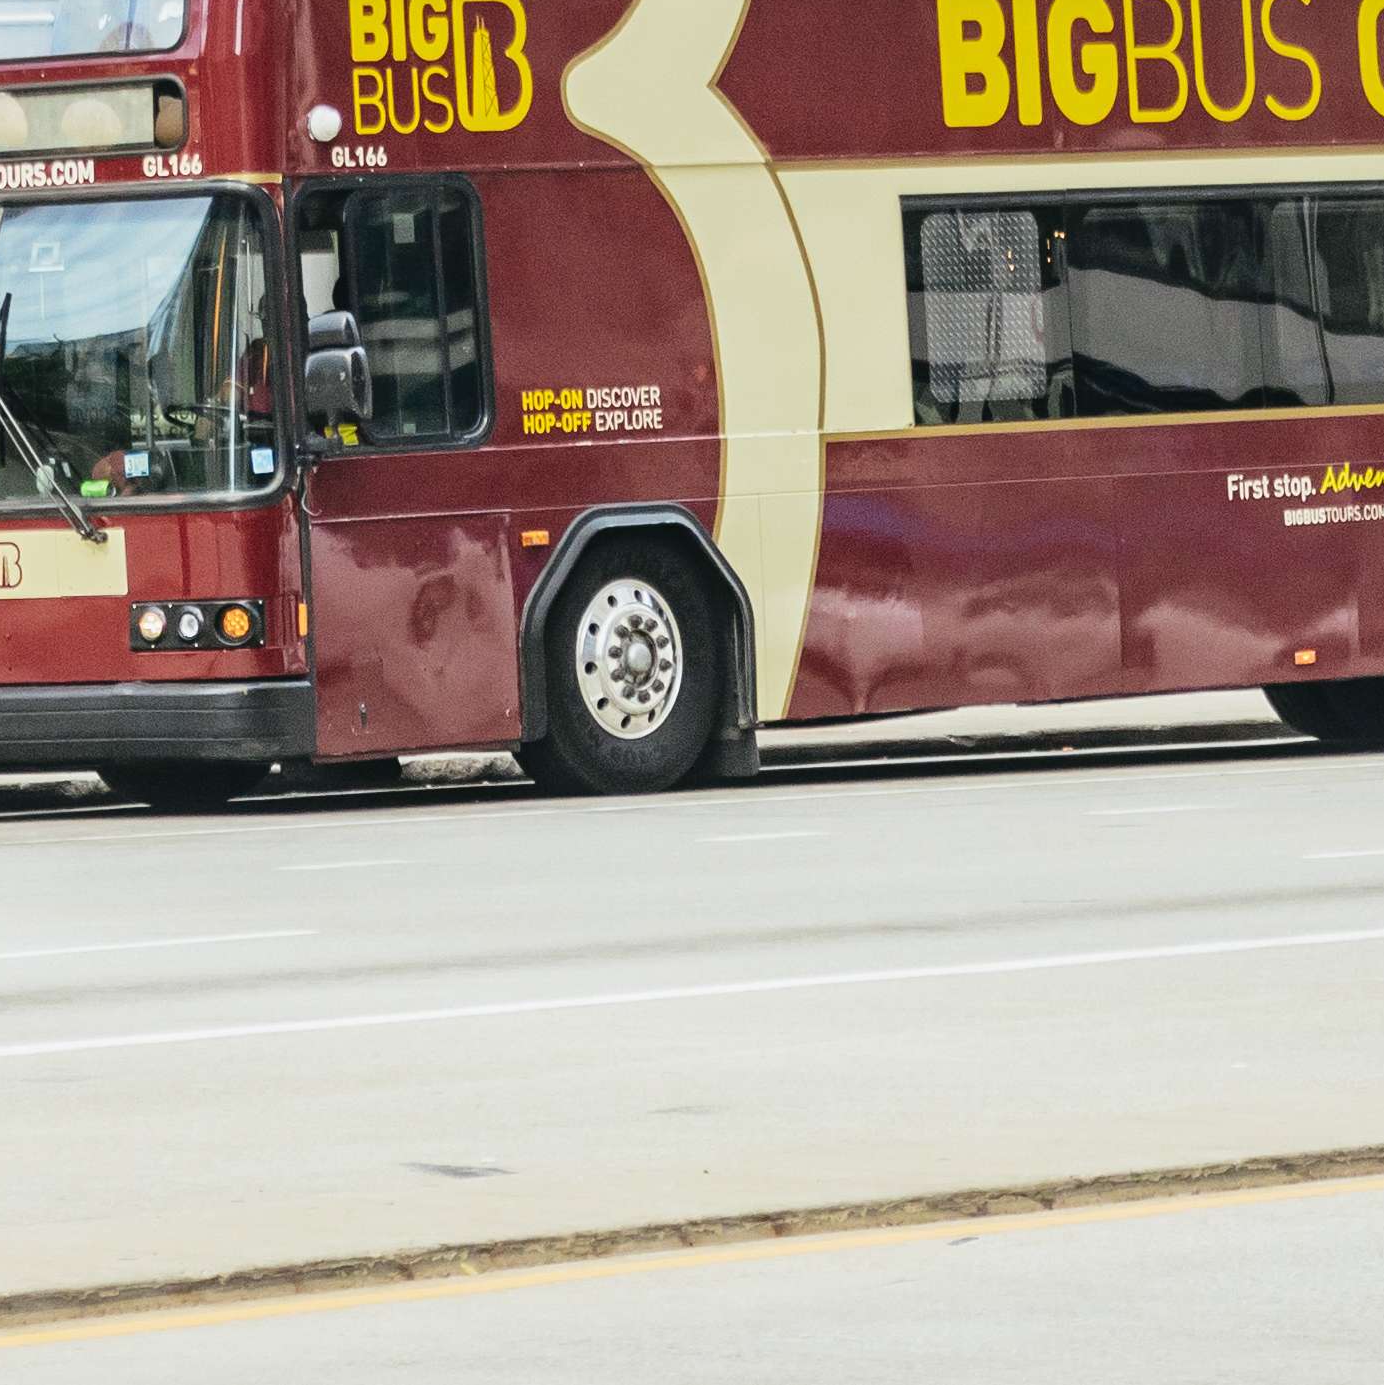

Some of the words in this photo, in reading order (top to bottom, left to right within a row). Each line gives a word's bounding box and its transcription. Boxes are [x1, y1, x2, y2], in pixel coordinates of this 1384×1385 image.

[351, 66, 454, 136] BUS
[142, 154, 203, 179] GL166
[330, 145, 388, 169] GL166
[521, 387, 583, 412] HOP-ON
[586, 385, 661, 409] DISCOVER
[523, 411, 592, 435] HOP-OFF
[595, 409, 663, 432] EXPLORE
[1227, 474, 1270, 501] First
[1273, 473, 1317, 502] stop.
